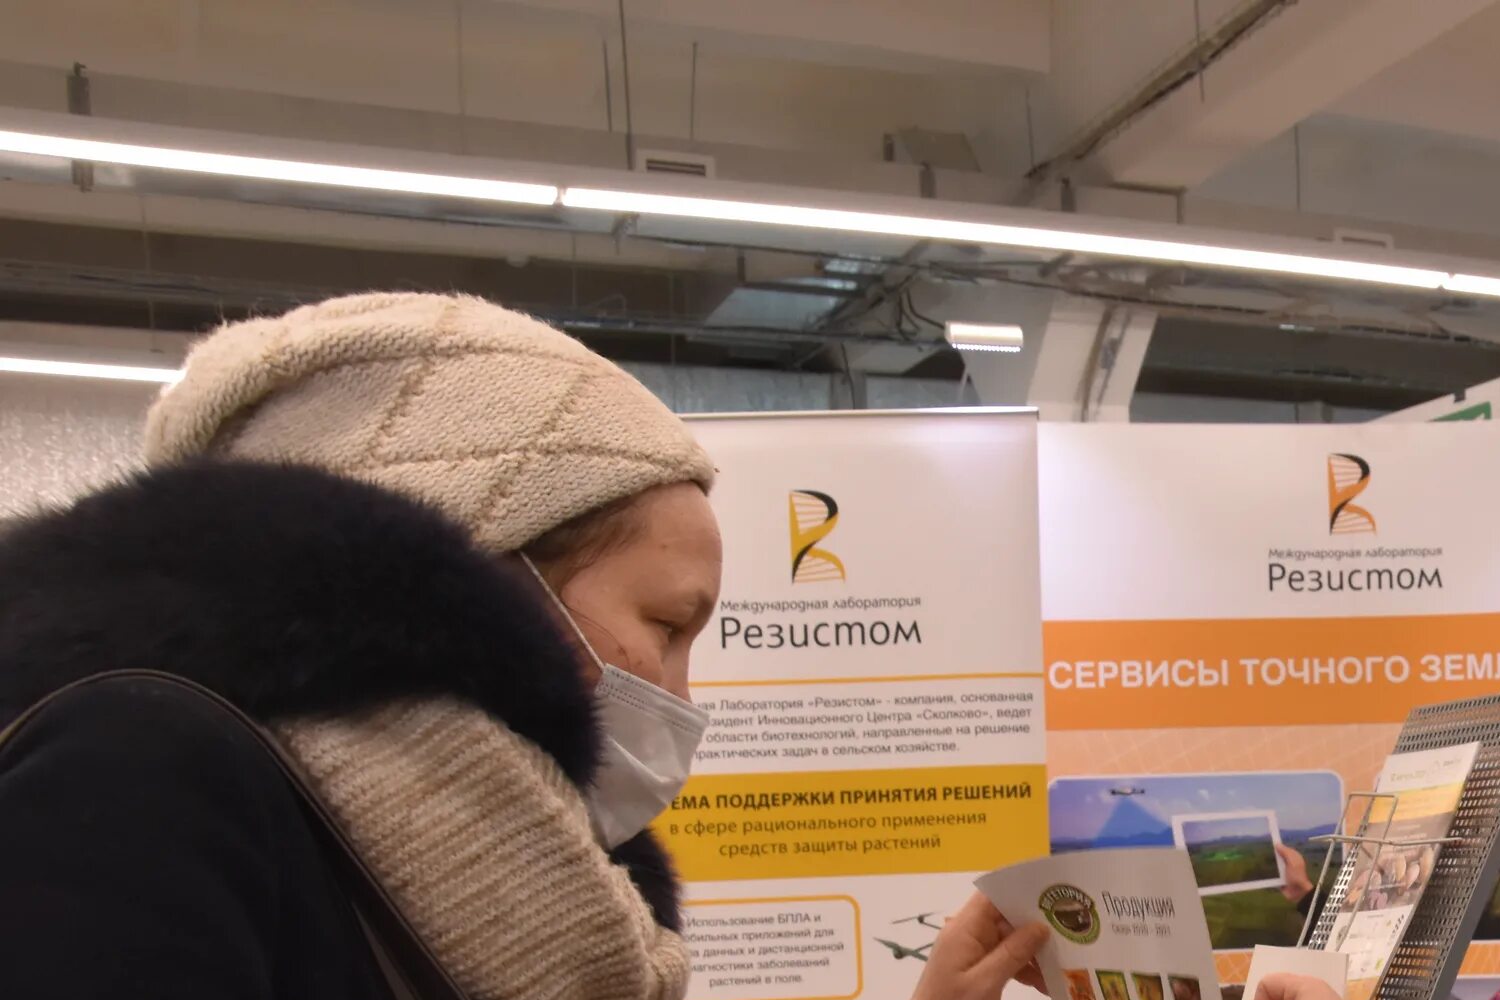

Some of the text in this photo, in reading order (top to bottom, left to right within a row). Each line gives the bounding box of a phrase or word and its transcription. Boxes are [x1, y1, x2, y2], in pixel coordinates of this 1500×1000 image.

[1268, 547, 1443, 561] Международная лаборатория
[1268, 563, 1443, 592] Резистом
[720, 596, 921, 615] Международная лаборатория
[720, 616, 922, 649] Резистом
[1049, 660, 1228, 689] СЕРВИСЫ
[1240, 656, 1410, 686] ТОЧНОГО
[720, 698, 803, 712] Лаборатория
[960, 692, 1033, 703] основанная
[706, 716, 753, 728] зидент
[758, 714, 863, 727] Инновационного
[867, 711, 912, 724] Центра
[996, 708, 1031, 719] ведет
[706, 732, 758, 744] области
[863, 725, 952, 739] направленные
[956, 725, 971, 735] на
[974, 722, 1030, 737] решение
[782, 746, 818, 758] задач
[832, 744, 891, 756] сельском
[895, 741, 960, 753] хозяйстве.
[716, 791, 835, 812] ПОДДЕРЖКИ
[840, 787, 938, 805] ПРИНЯТИЯ
[942, 782, 1032, 801] РЕШЕНИЙ
[670, 811, 987, 837] в сфере рационального применения
[718, 834, 942, 858] средств защиты растений
[1101, 889, 1175, 922] Продукция
[687, 916, 775, 928] Использование
[685, 928, 834, 944] обильных приложений для
[702, 946, 745, 958] данных
[758, 942, 844, 956] дистанционной
[757, 957, 830, 970] заболеваний
[709, 974, 762, 988] растений
